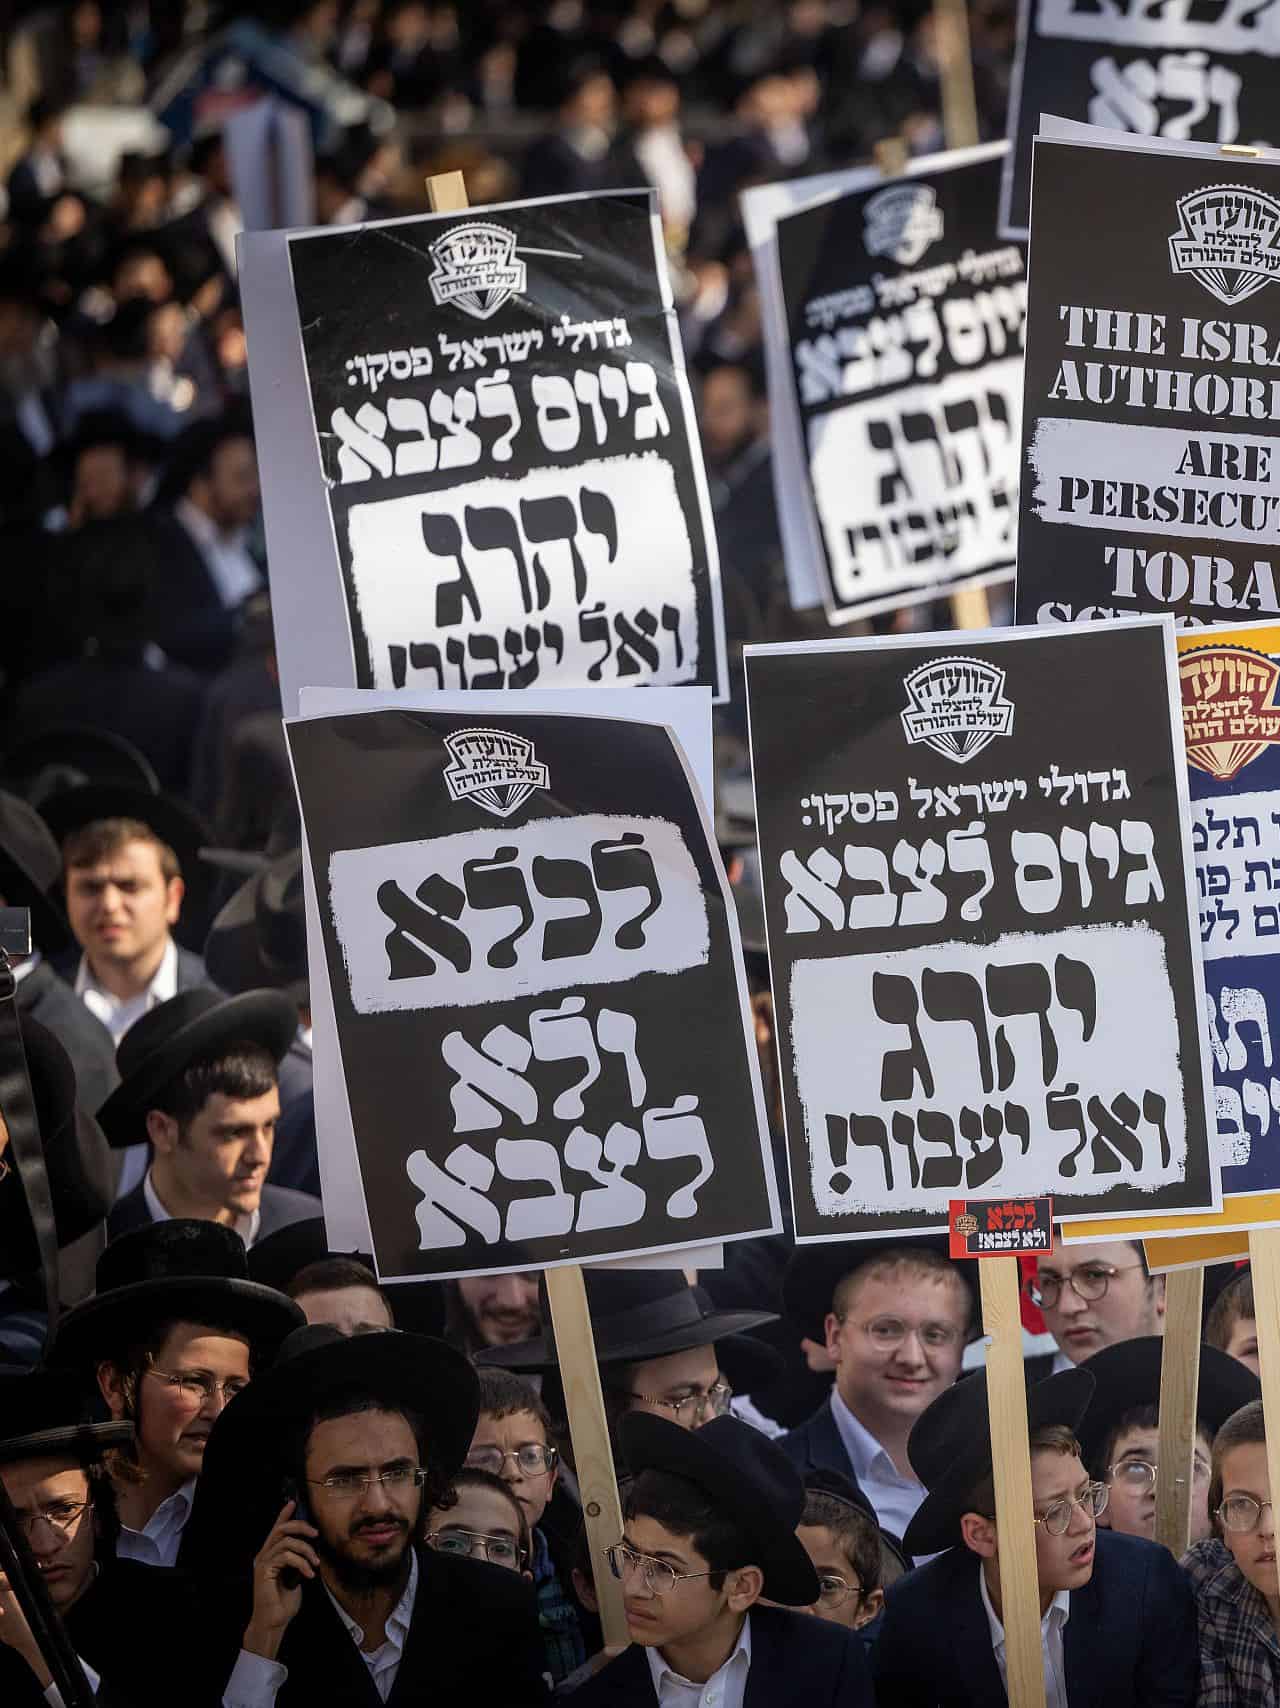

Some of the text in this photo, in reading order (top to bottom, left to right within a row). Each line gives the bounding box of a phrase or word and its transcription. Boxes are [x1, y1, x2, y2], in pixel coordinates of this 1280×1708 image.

[1188, 195, 1279, 232] הוועדה
[1180, 247, 1236, 262] התורה
[1203, 230, 1262, 248] להצלת
[1059, 305, 1167, 355] THE
[345, 315, 633, 393] גדולי ישראל פסקו:
[331, 362, 671, 484] גיוס לצבא
[867, 391, 1013, 506] יהרג
[1175, 440, 1272, 483] ARE
[421, 486, 618, 628] יהרג
[579, 601, 683, 681] ואל
[915, 666, 995, 699] הוועדה
[1180, 656, 1270, 700] הוועד
[912, 711, 1004, 733] עולם התורה
[932, 696, 983, 713] להצלת
[1182, 696, 1253, 720] להצלת
[455, 735, 526, 757] הוועדה
[1184, 720, 1224, 741] התו
[455, 767, 541, 790] עולם התורה
[472, 755, 519, 769] להצלת
[800, 764, 1132, 835] גדולי ישראל פסקו:
[1192, 807, 1261, 852] תלמ
[779, 819, 1164, 933] גיוס לצבא
[1195, 864, 1231, 898] פו
[376, 832, 663, 981] לכלא
[872, 953, 1097, 1101] יהרג
[441, 996, 647, 1133] ולא
[825, 1083, 1171, 1195] ואל יעבור!
[406, 1094, 715, 1251] לצבא
[987, 1201, 1038, 1230] לכלא
[1022, 1228, 1047, 1248] ולא
